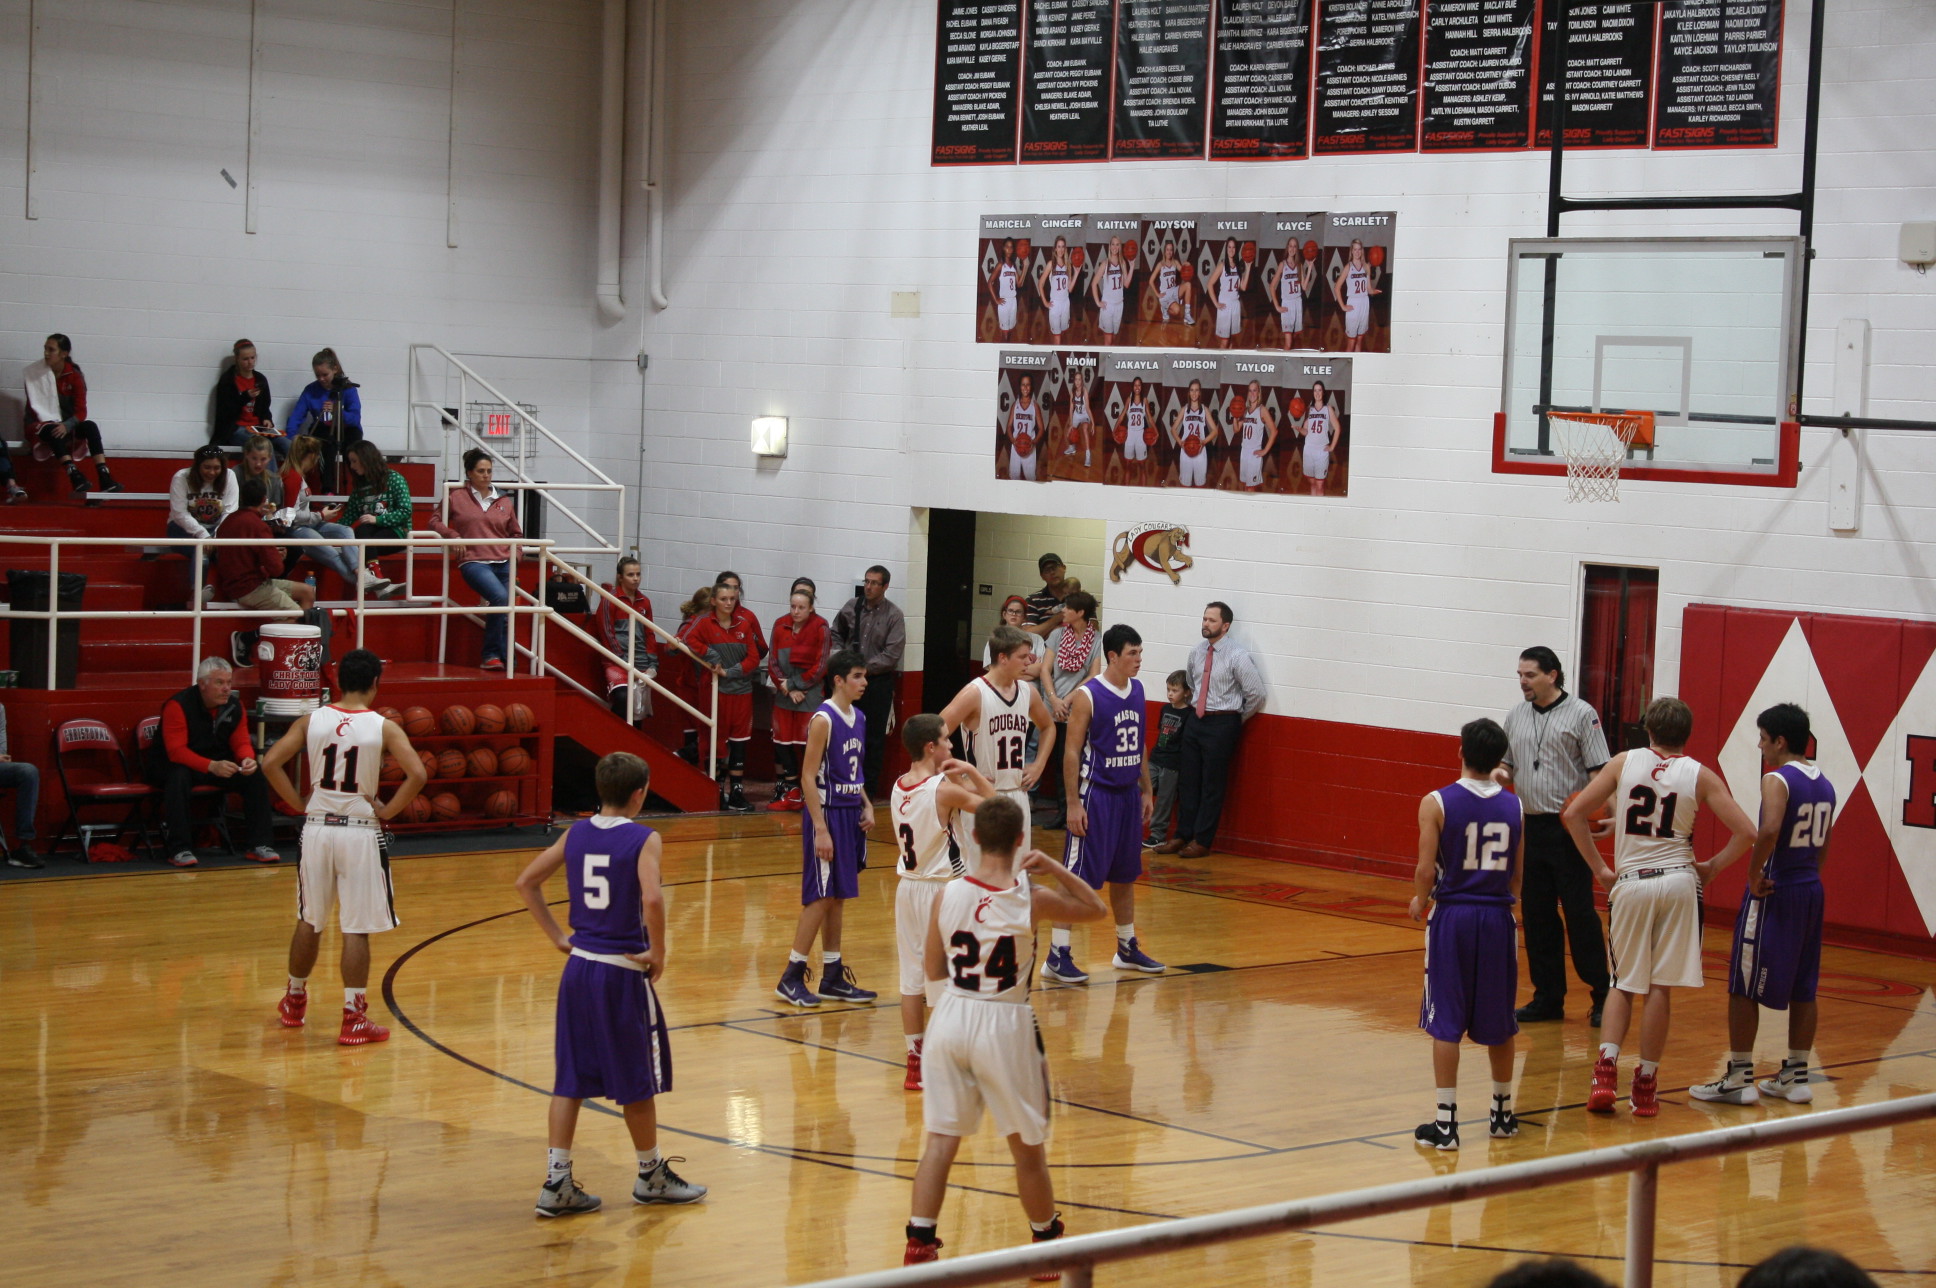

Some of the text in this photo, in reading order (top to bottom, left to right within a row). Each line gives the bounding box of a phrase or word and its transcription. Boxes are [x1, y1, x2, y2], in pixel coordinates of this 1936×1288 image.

[1580, 5, 1631, 15] JONES WHITE
[1663, 7, 1750, 19] JAKAYLA HALBROOKS MICAELA
[1431, 16, 1478, 26] CARLY ARCHULETA
[1467, 28, 1501, 38] HILL SIERRA
[1569, 32, 1623, 43] JAKAYLA HALBROOKS
[1670, 34, 1692, 43] KAITLYN
[1450, 47, 1507, 57] COACH: MATT GARRETT
[1674, 44, 1746, 55] KAYCE JACKSON TAYLOR
[1337, 65, 1356, 73] COACH:
[1432, 59, 1499, 69] ASSISTANT COACH: LAUREN
[1224, 75, 1250, 83] ASSISTANT
[1327, 76, 1352, 84] ASSISTANT
[1430, 70, 1502, 81] ASSISTANT COACH: COURTNEY
[1435, 83, 1481, 92] ASSISTANT COACH:
[1619, 80, 1641, 88] GARRETT
[1225, 86, 1250, 94] ASSISTANT
[1327, 88, 1352, 96] ASSISTANT
[1324, 99, 1350, 107] ASSISTANT
[1472, 94, 1491, 102] ASHLEY
[1477, 105, 1494, 113] MASON
[1590, 103, 1613, 111] GARRETT
[1472, 117, 1495, 125] GARRETT
[1425, 131, 1474, 141] FASTSIGNS
[1659, 127, 1715, 138] FASTSIGNS
[1116, 139, 1160, 148] FASTSIGNS
[1213, 139, 1260, 149] FASTSIGNS
[1318, 134, 1365, 144] FASTSIGNS
[936, 145, 976, 154] FASTSIGNS
[1025, 142, 1067, 151] FASTSIGNS
[986, 220, 1031, 229] MARICELA
[1042, 219, 1082, 228] GINGER
[1097, 221, 1137, 230] KAITLYN
[1154, 220, 1195, 229] ADYSON
[1217, 221, 1247, 230] KYLEI
[1333, 216, 1388, 226] SCARLETT
[1276, 222, 1312, 231] KAYCE
[1288, 281, 1299, 295] 15
[1354, 280, 1366, 294] 20
[1005, 356, 1046, 365] DEZERAY
[1066, 357, 1096, 367] NAOMI
[1116, 361, 1159, 370] JAKAYLA
[1172, 360, 1216, 370] ADDISON
[1236, 363, 1275, 373] TAYLOR
[1304, 365, 1332, 375] K'LEE
[488, 414, 510, 435] EXIT
[1311, 420, 1323, 434] 45
[1127, 523, 1173, 542] LADY COUGARS
[269, 680, 291, 689] LADY
[1114, 709, 1139, 727] MASON
[63, 727, 111, 742] CHRISTOVAL
[1116, 726, 1139, 753] 33
[997, 736, 1022, 770] 12
[320, 743, 359, 793] 11
[849, 756, 858, 781] 3
[1625, 784, 1678, 838] 21
[1790, 802, 1831, 848] 20
[900, 823, 917, 871] 3
[1463, 822, 1510, 871] 12
[583, 854, 610, 910] 5
[951, 930, 1018, 992] 24
